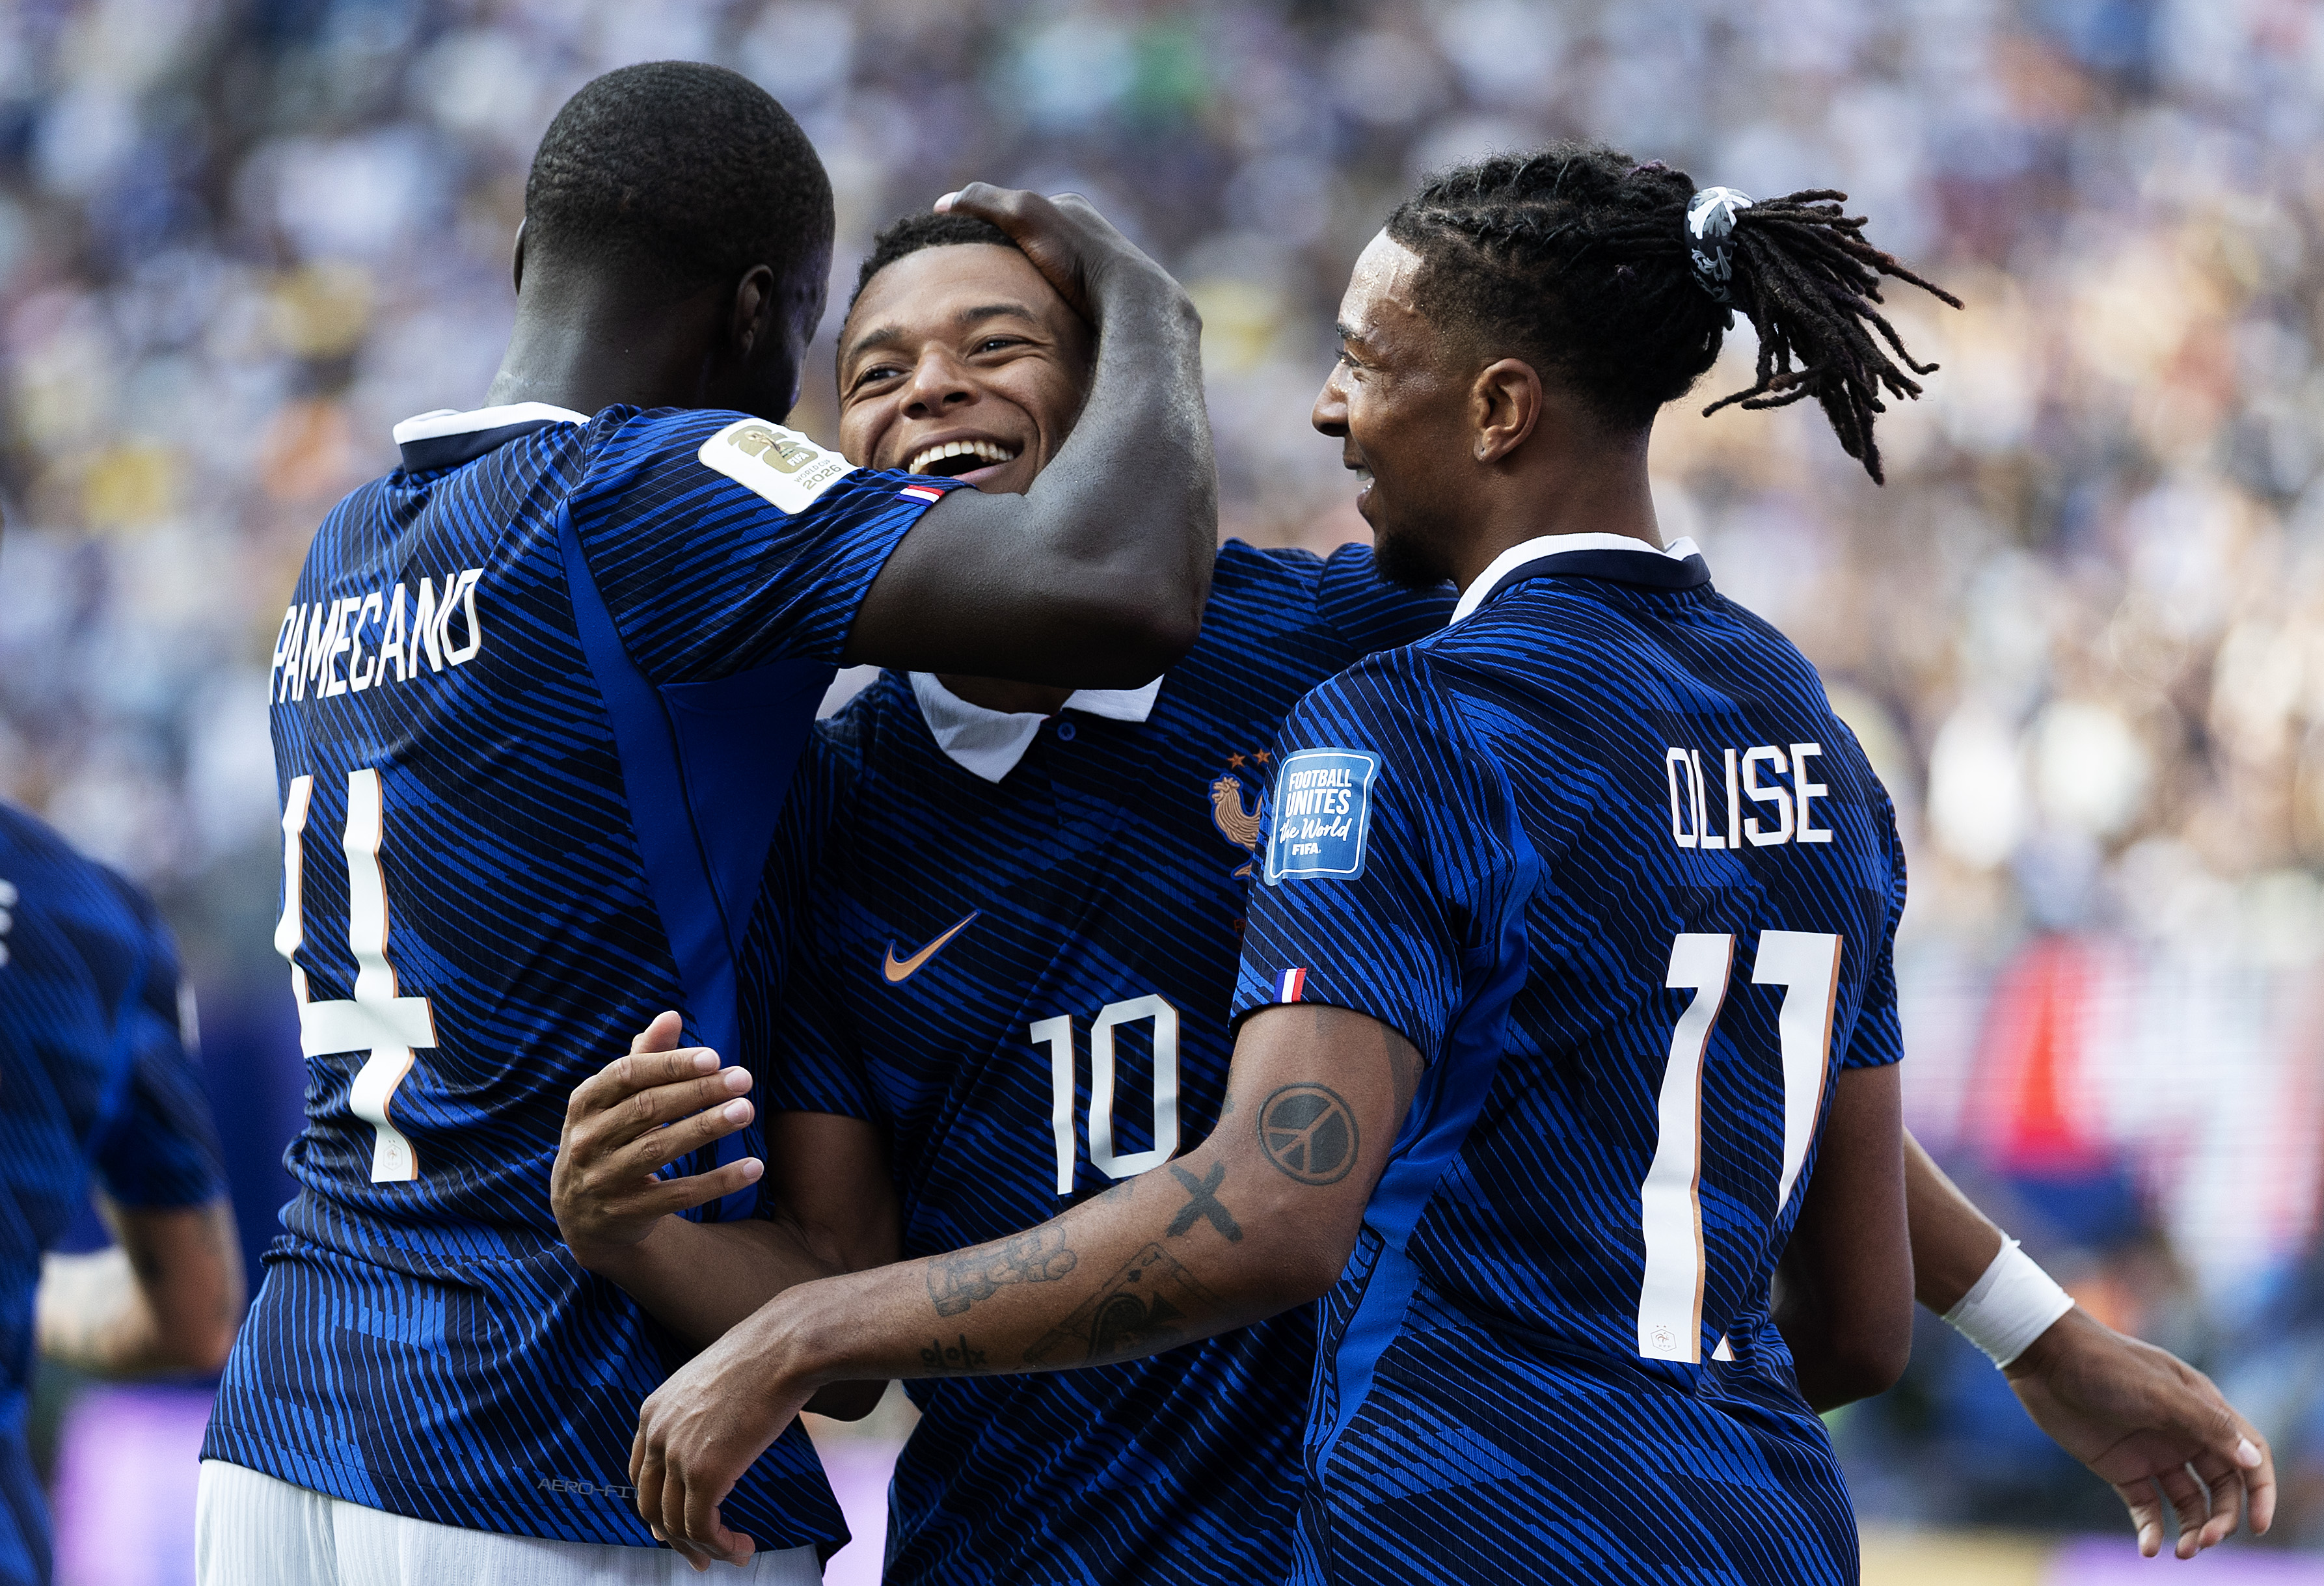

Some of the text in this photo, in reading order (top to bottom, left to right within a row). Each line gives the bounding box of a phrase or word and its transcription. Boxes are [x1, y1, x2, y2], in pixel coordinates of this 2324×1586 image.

[787, 451, 810, 466] FIFA
[794, 464, 819, 483] WORLD
[802, 464, 842, 491] 2026
[269, 568, 483, 705] PAMECANO
[1289, 768, 1352, 792] FOOTBALL
[1285, 788, 1352, 818] UNITES
[1666, 742, 1833, 849] OLISE
[1280, 815, 1353, 844] the World
[1292, 842, 1319, 855] FIFA
[274, 768, 439, 1183] 4
[1030, 993, 1180, 1195] 10
[1638, 930, 1843, 1364] 11
